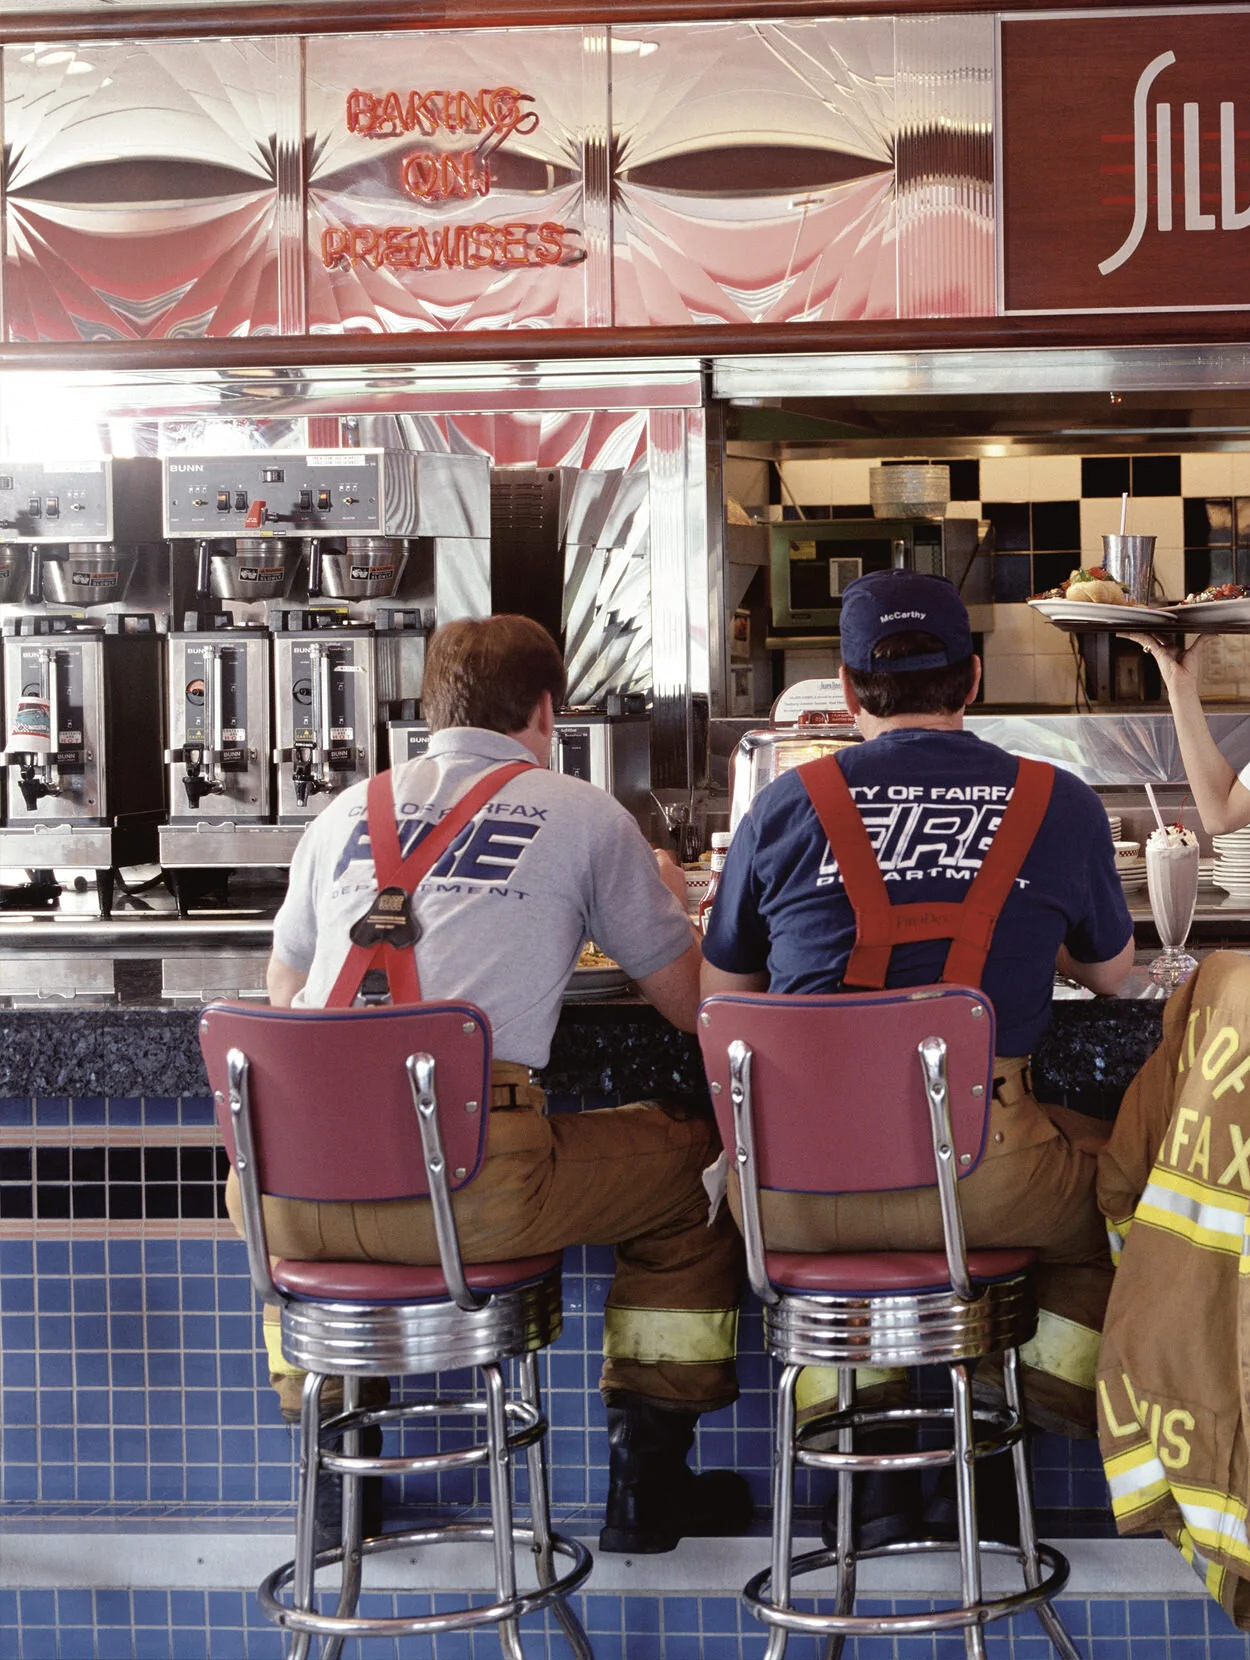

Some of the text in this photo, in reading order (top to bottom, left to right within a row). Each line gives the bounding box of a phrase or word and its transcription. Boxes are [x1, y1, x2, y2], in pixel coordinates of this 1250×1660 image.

[346, 86, 521, 136] BAKING
[403, 153, 472, 200] ON
[321, 222, 566, 270] PREMISES
[169, 464, 204, 473] BUNN
[879, 611, 926, 623] McCarthy
[848, 786, 1014, 800] TY OF FAIRF
[400, 803, 435, 815] OF
[331, 883, 530, 900] DEPTMENT
